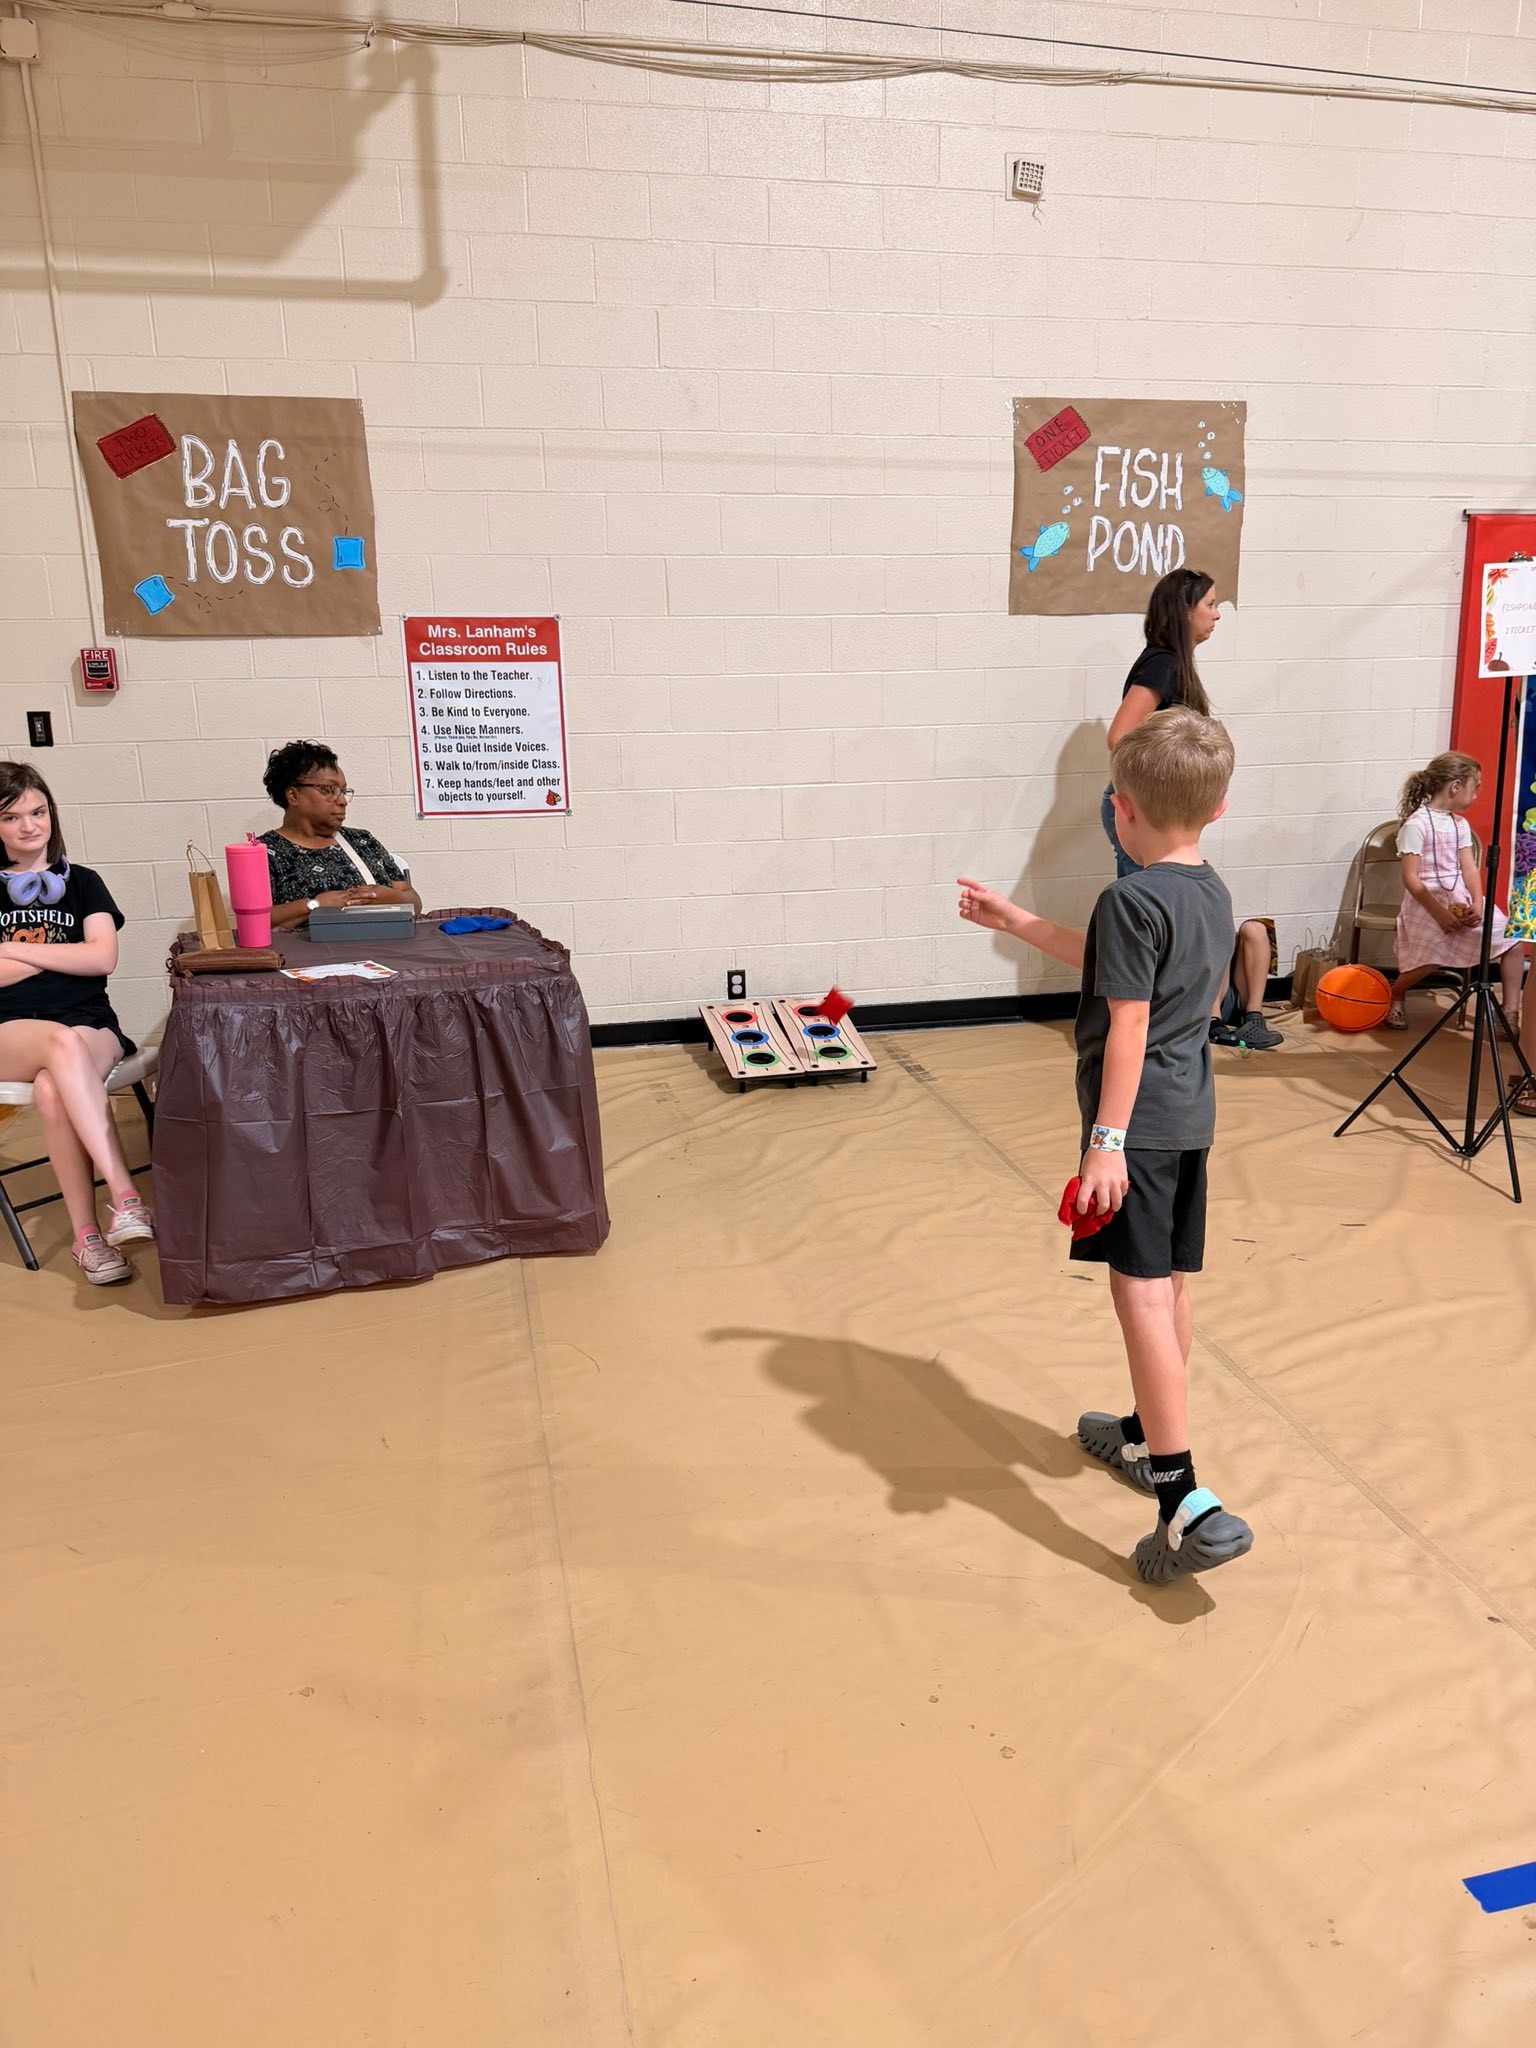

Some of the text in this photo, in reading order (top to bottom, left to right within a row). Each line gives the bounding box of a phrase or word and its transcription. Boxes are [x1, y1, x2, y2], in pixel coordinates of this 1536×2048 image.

[112, 426, 147, 449] TWO
[1035, 418, 1067, 447] ONE
[114, 436, 166, 467] TICKETS
[1038, 427, 1083, 464] TICKET
[181, 434, 291, 509] BAG
[1093, 445, 1183, 511] FISH
[166, 517, 315, 588] TOSS
[1086, 515, 1186, 576] POND
[427, 624, 536, 638] Mrs. Lanham's
[83, 650, 109, 660] FIRE
[419, 642, 548, 656] Classroom Rules
[416, 670, 533, 681] 1. Listen to the Teacher.
[418, 688, 516, 699] 2. Follow Directions.
[419, 706, 530, 719] 3. Be Kind to Everyone.
[421, 724, 524, 735] 4. Use Nice Manners.
[422, 741, 549, 753] 5. Use Quiet Inside Voices.
[423, 759, 560, 771] 6. Walk to/from/inside Class.
[425, 776, 561, 790] 7. Keep hands/feet and other
[438, 790, 526, 803] objects to yourself.
[0, 909, 75, 927] OTTSFIELD
